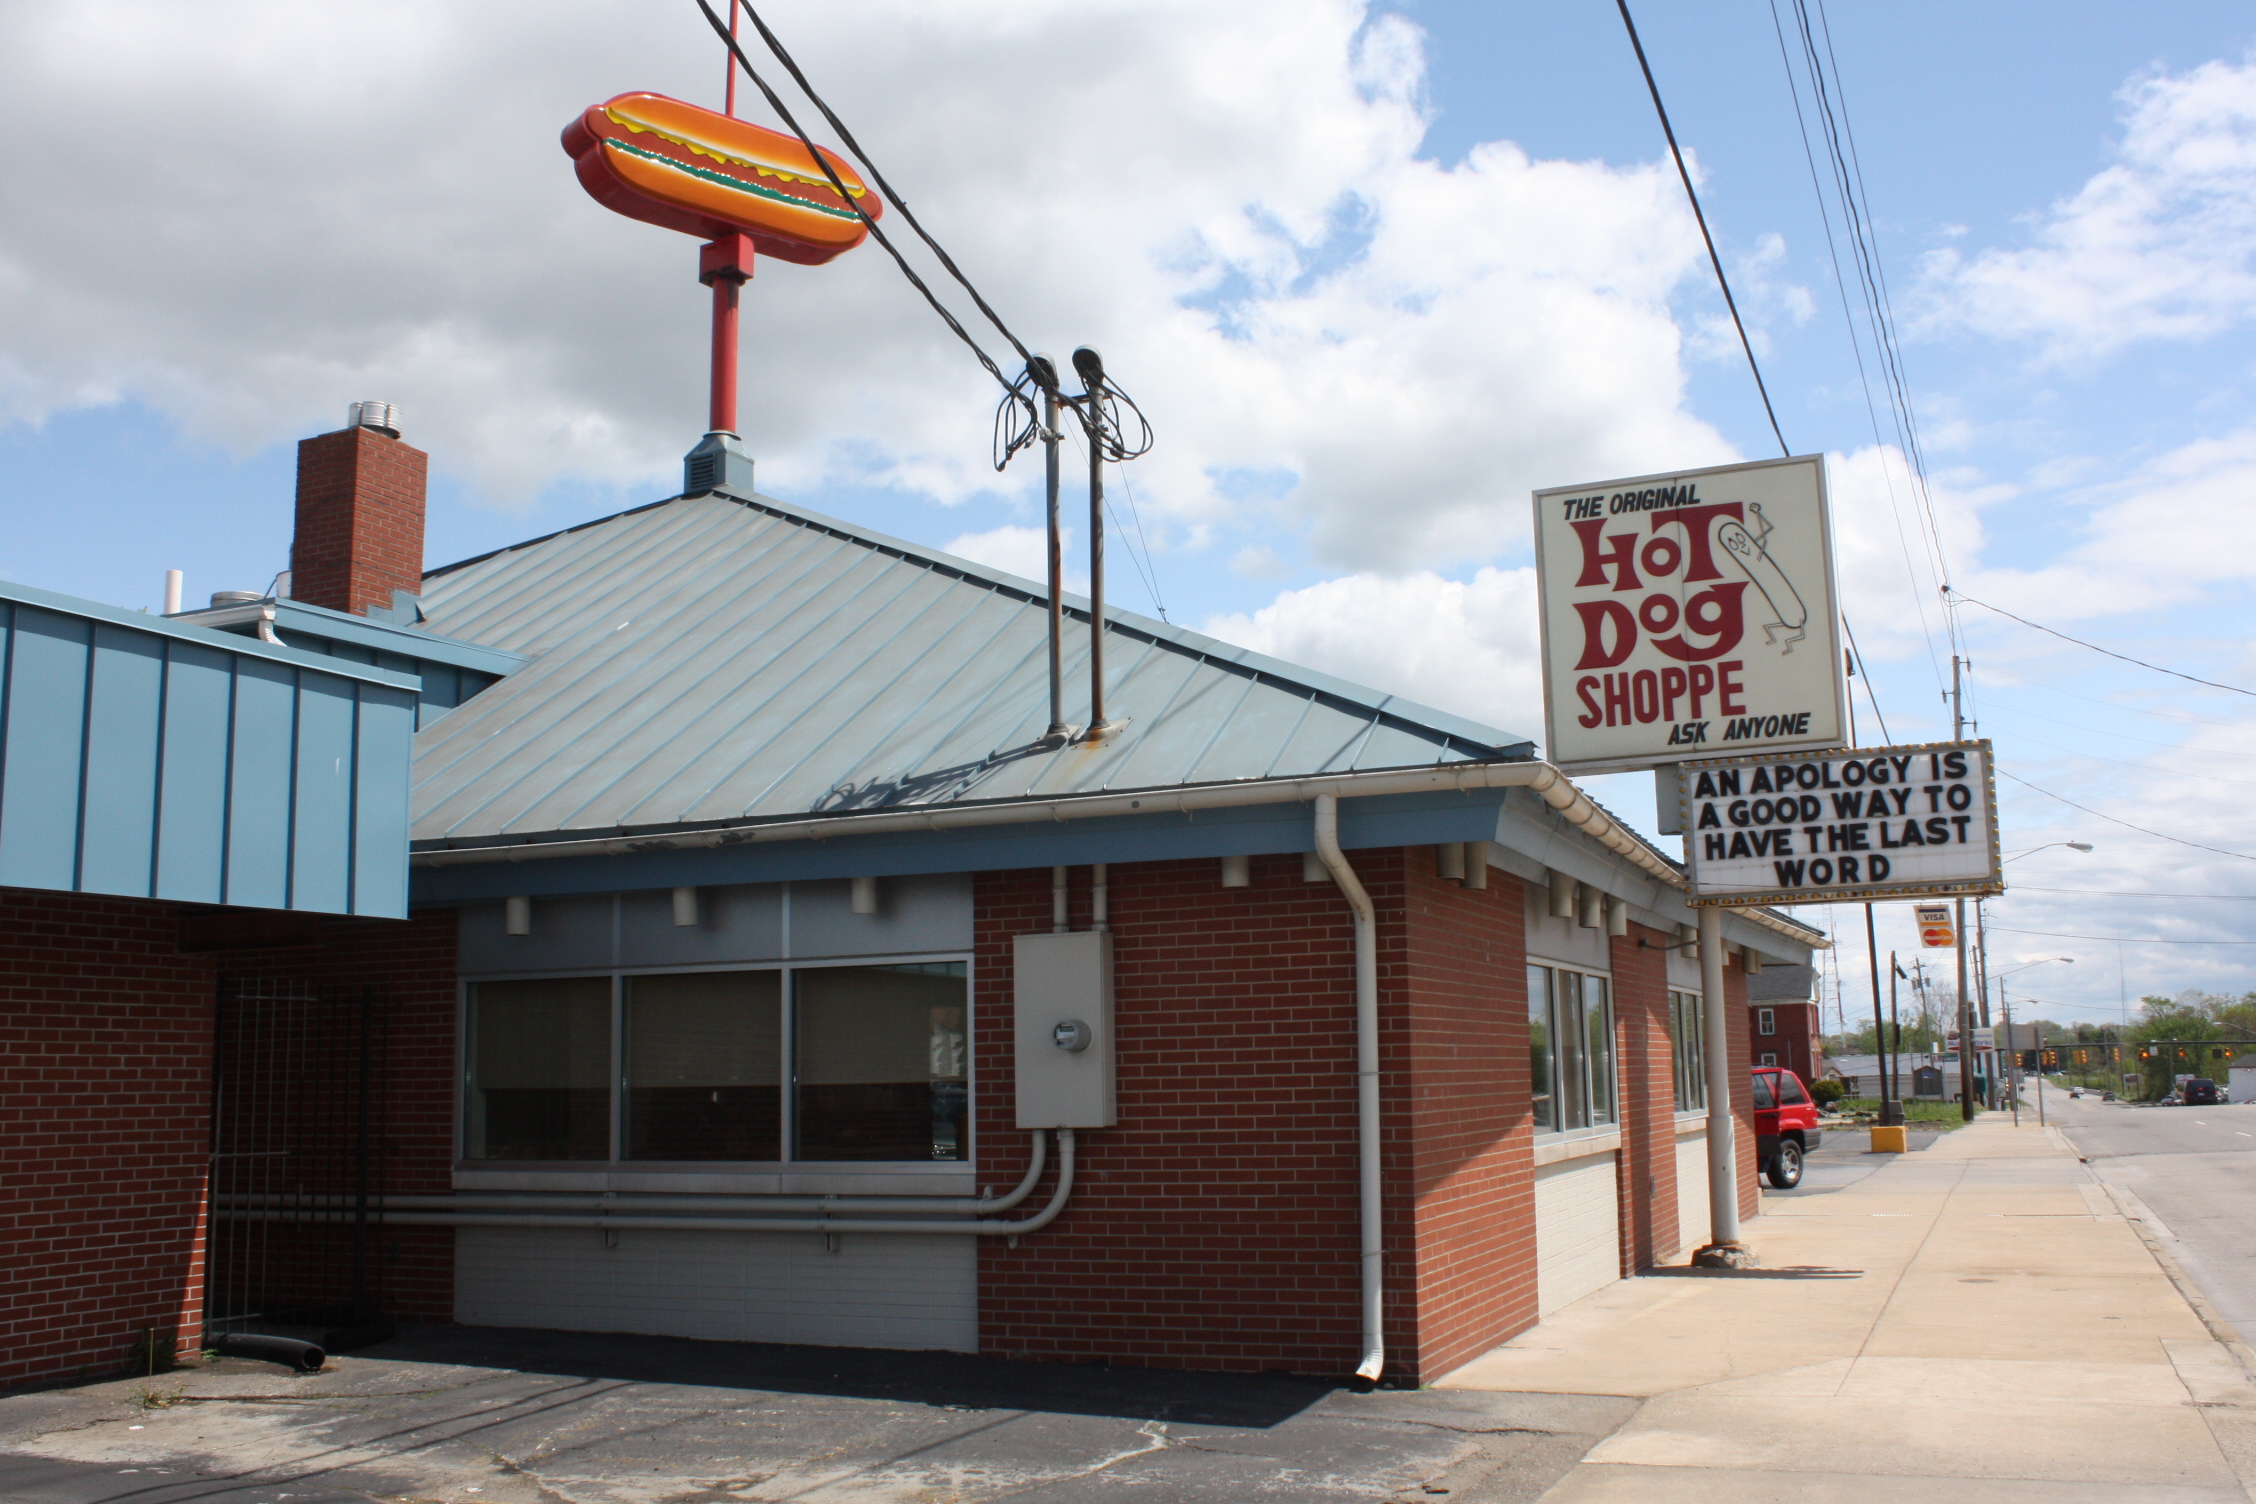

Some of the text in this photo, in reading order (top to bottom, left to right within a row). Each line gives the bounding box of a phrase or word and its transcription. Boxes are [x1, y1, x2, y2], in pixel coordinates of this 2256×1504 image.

[1563, 484, 1701, 520] THE ORIGINAL
[1576, 660, 1747, 729] SHOPPE
[1667, 712, 1811, 745] ASK ANYONE
[1694, 752, 1968, 799] AN APOLOGY IS
[1698, 784, 1972, 830] A GOOD WAY TO
[1705, 815, 1972, 860] HAVE THE LAST
[1774, 854, 1891, 888] WORD
[1924, 913, 1945, 921] VISA
